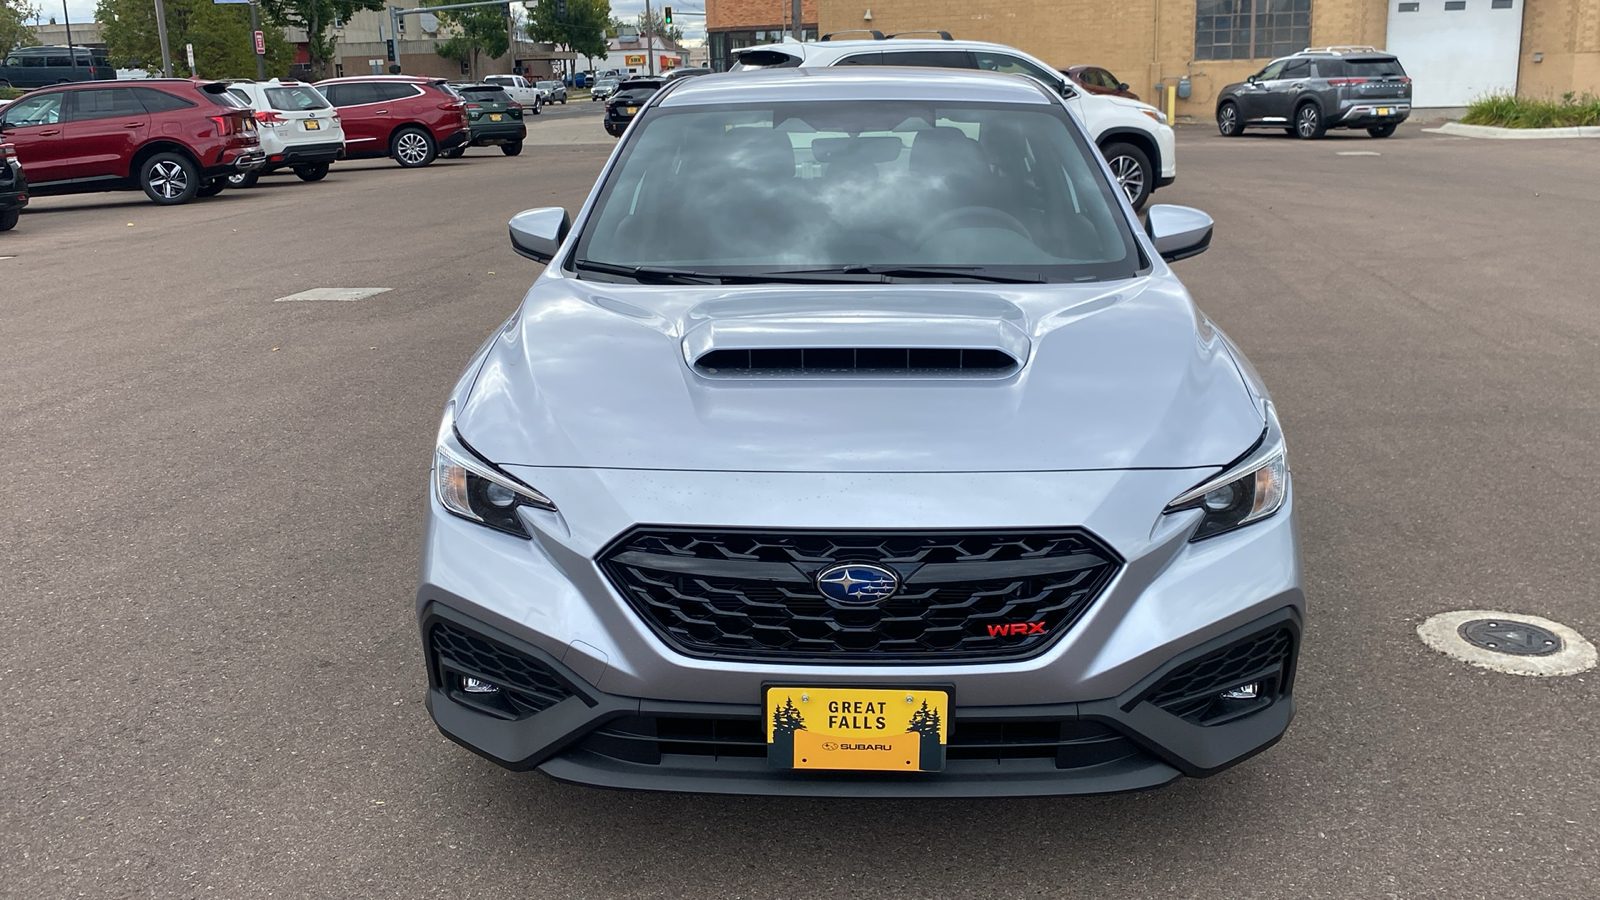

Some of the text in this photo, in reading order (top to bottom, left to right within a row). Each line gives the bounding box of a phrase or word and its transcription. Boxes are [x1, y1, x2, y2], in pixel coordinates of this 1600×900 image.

[987, 621, 1047, 638] WRX
[828, 701, 886, 714] GREAT
[828, 715, 886, 730] FALLS
[840, 743, 892, 751] SUBARU
